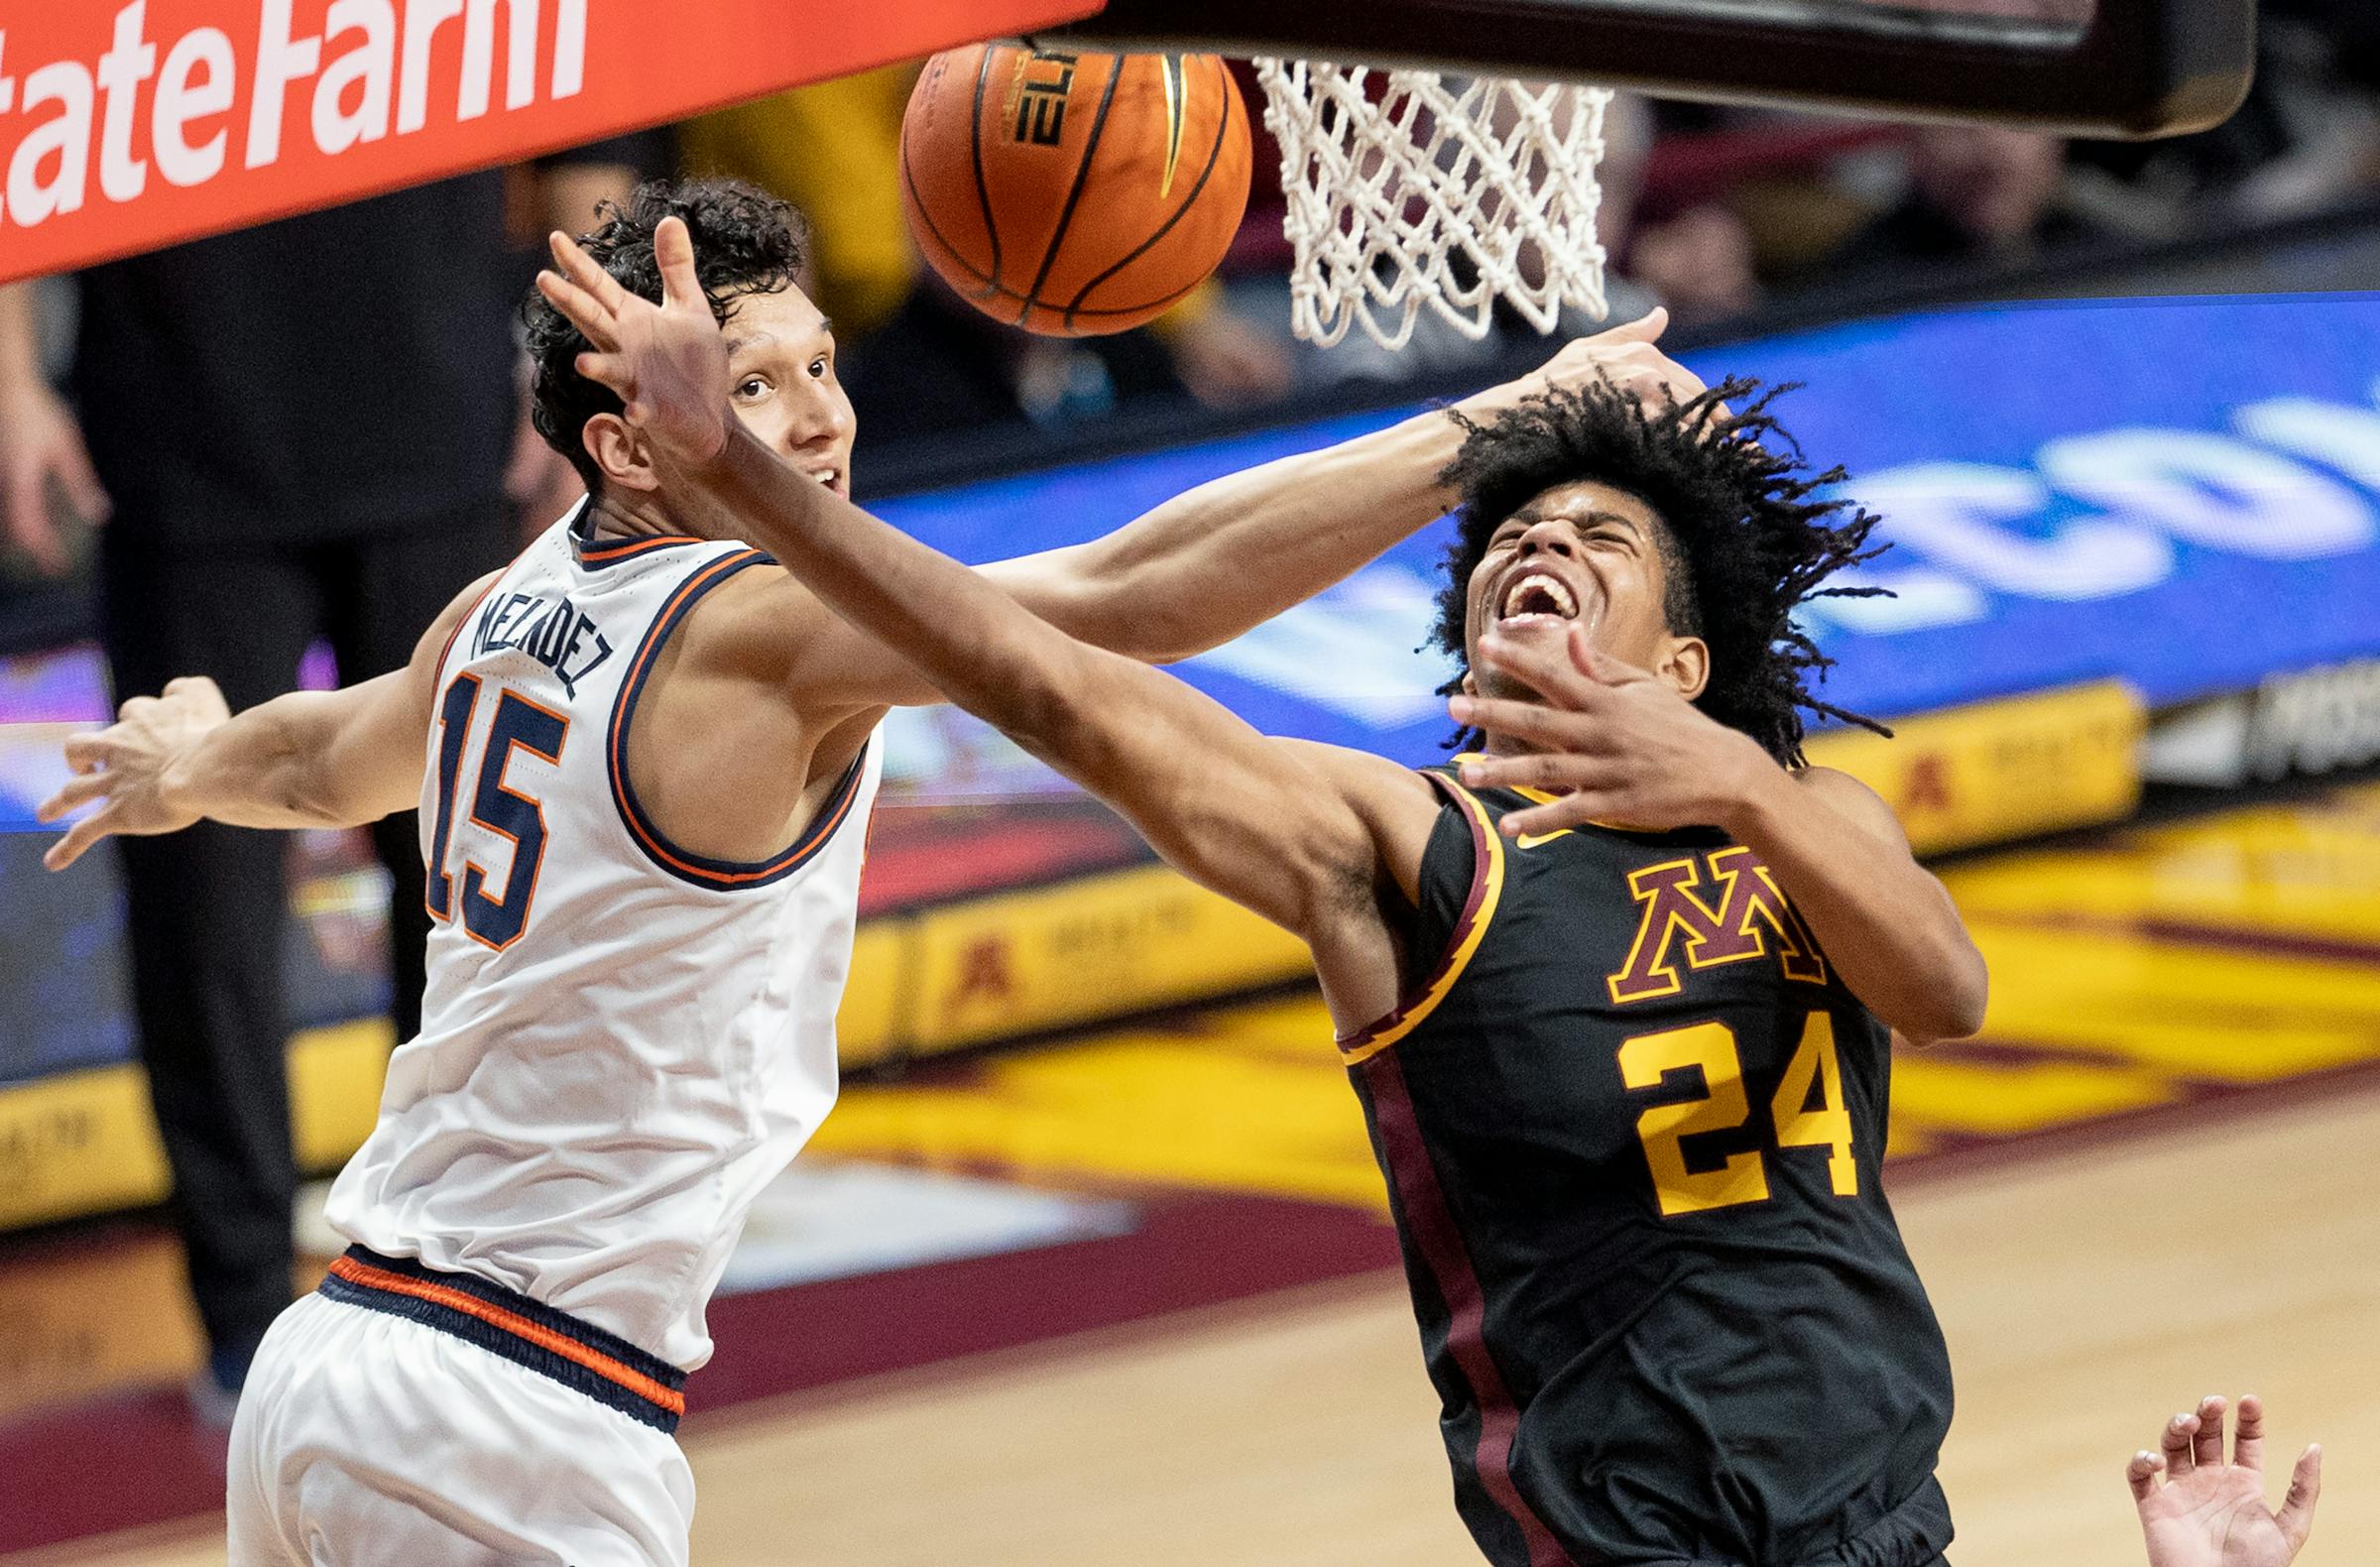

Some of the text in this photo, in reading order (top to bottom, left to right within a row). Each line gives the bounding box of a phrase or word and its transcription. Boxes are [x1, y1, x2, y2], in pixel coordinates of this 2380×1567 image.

[424, 670, 570, 953] 15
[1606, 845, 1828, 1005] M
[1617, 1010, 1858, 1217] 24
